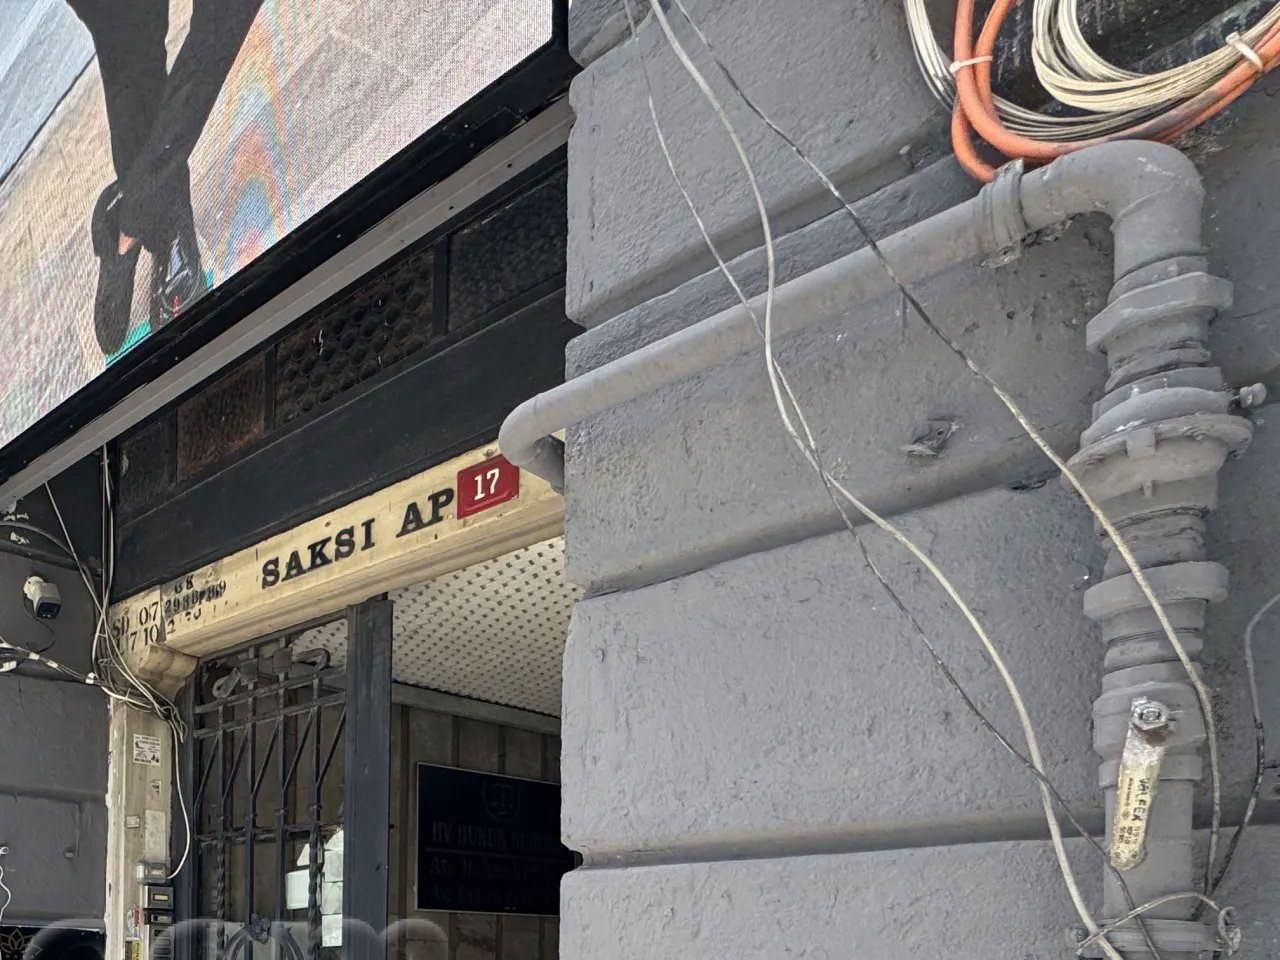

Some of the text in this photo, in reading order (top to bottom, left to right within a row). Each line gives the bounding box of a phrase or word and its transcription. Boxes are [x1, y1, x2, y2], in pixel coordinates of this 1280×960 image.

[472, 468, 503, 501] 17
[261, 486, 456, 591] SAKSI AP
